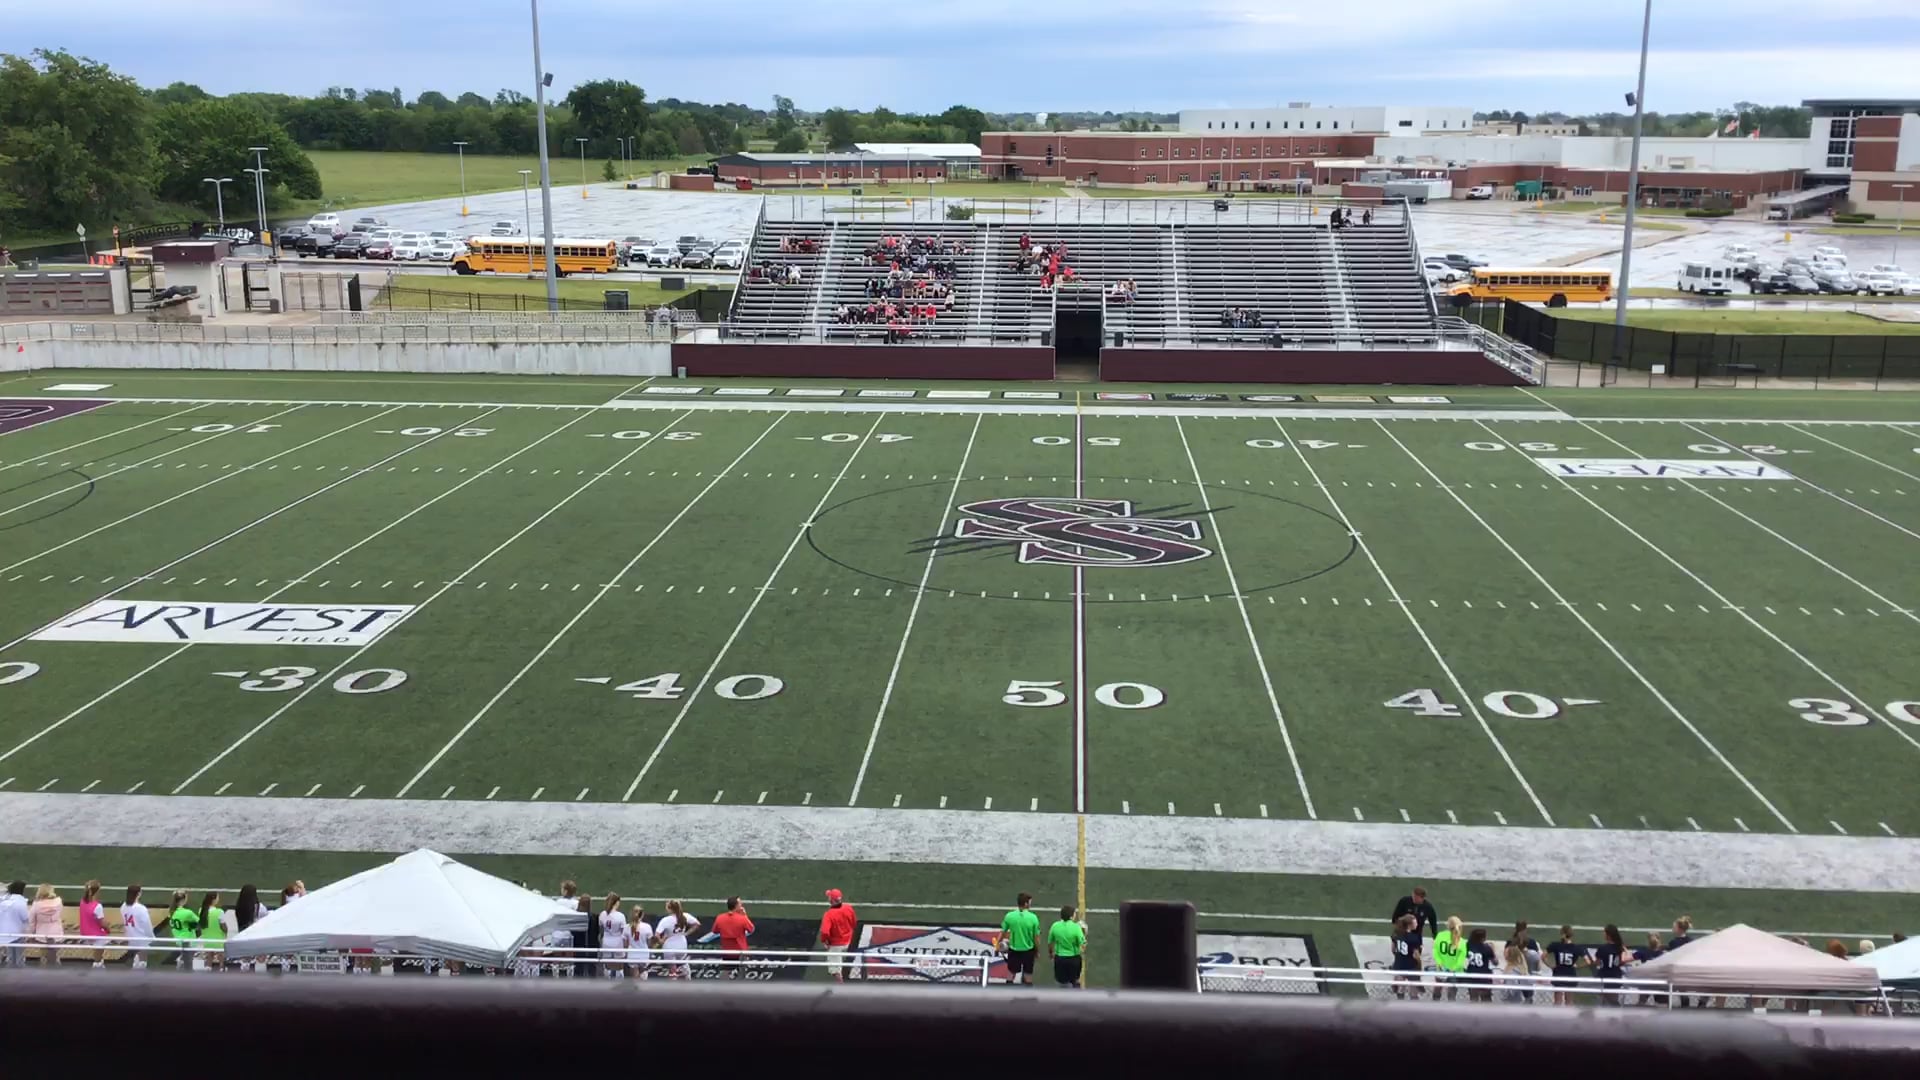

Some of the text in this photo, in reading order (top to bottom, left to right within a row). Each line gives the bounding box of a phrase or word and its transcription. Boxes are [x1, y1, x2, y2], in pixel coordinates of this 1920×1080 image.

[62, 605, 402, 640] ARVEST
[124, 913, 136, 928] 14
[1560, 952, 1574, 967] 15
